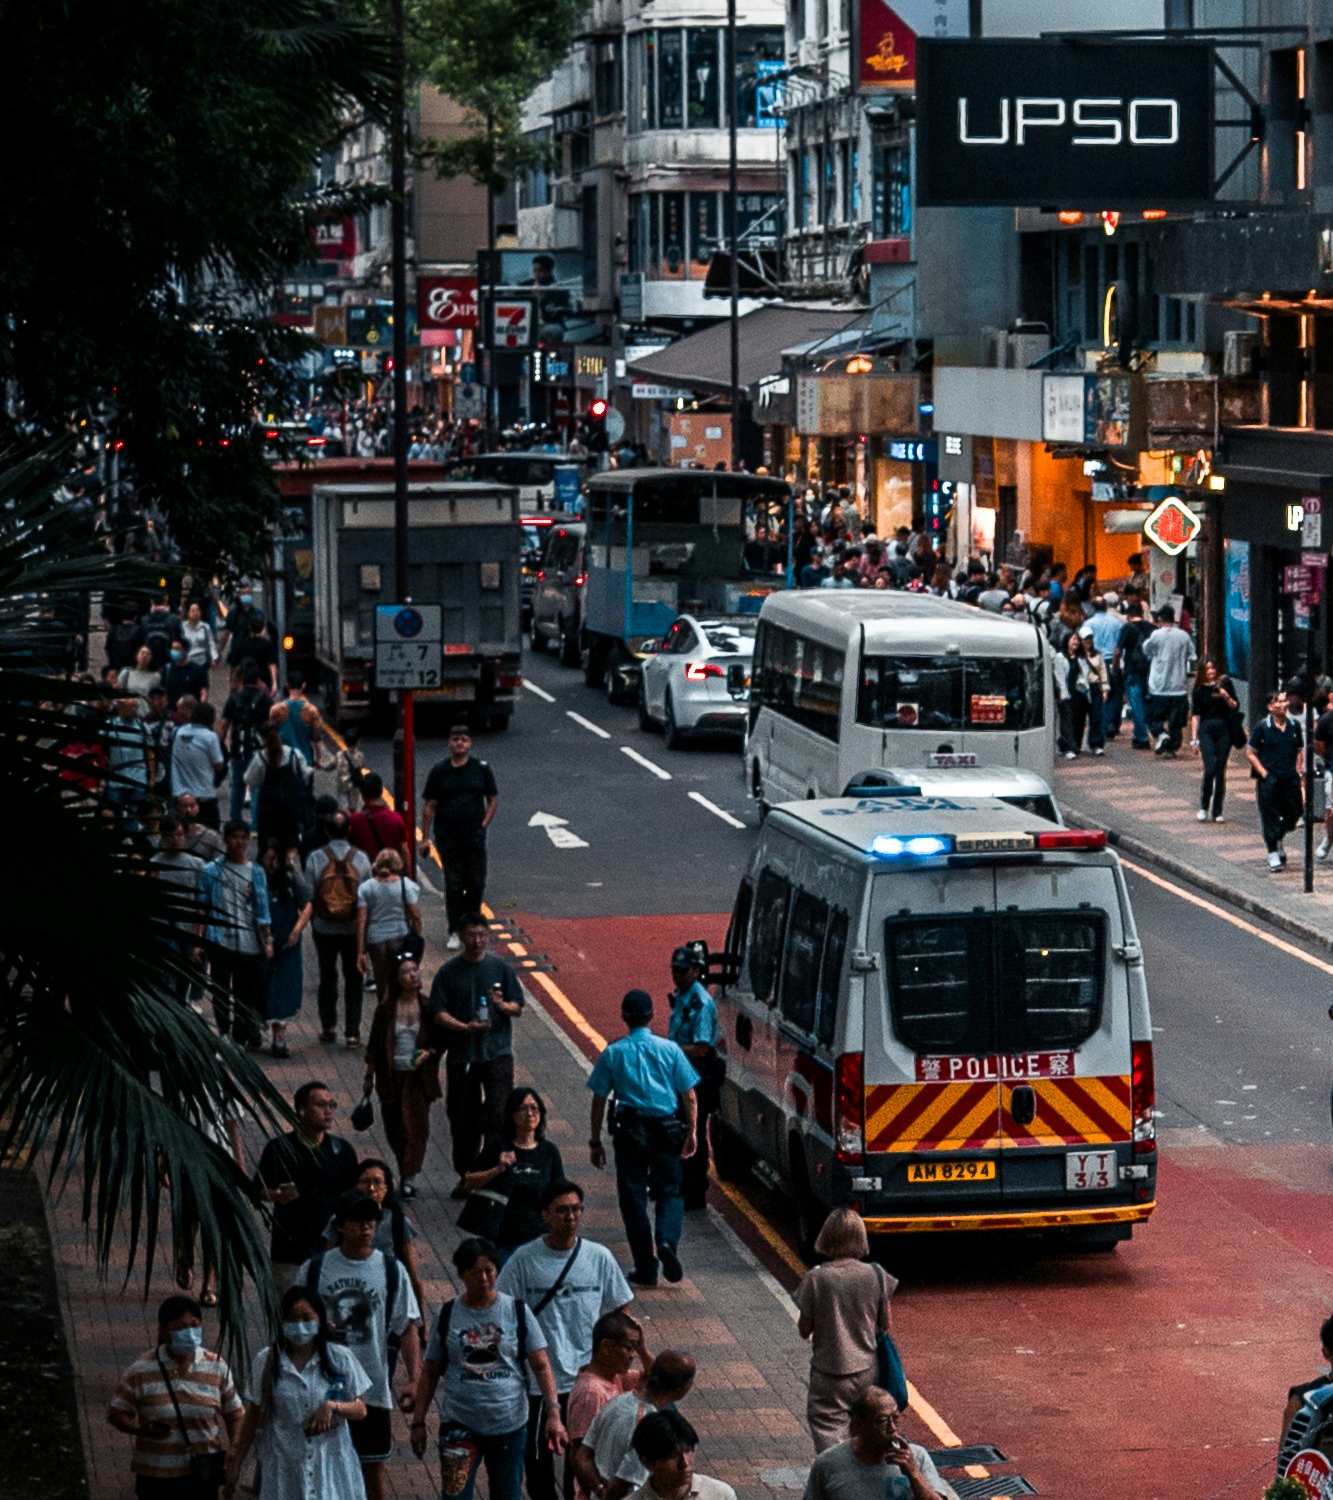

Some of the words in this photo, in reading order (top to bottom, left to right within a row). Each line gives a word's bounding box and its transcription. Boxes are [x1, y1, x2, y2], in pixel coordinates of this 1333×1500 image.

[957, 96, 1180, 147] UPSO
[417, 645, 429, 661] 7
[417, 669, 438, 686] 12
[933, 755, 976, 766] TAXI
[975, 839, 1016, 850] POLICE
[920, 1057, 941, 1080] 警
[949, 1055, 1040, 1080] POLICE
[1048, 1052, 1072, 1076] 察
[912, 1163, 938, 1180] AM
[941, 1161, 991, 1179] 8294
